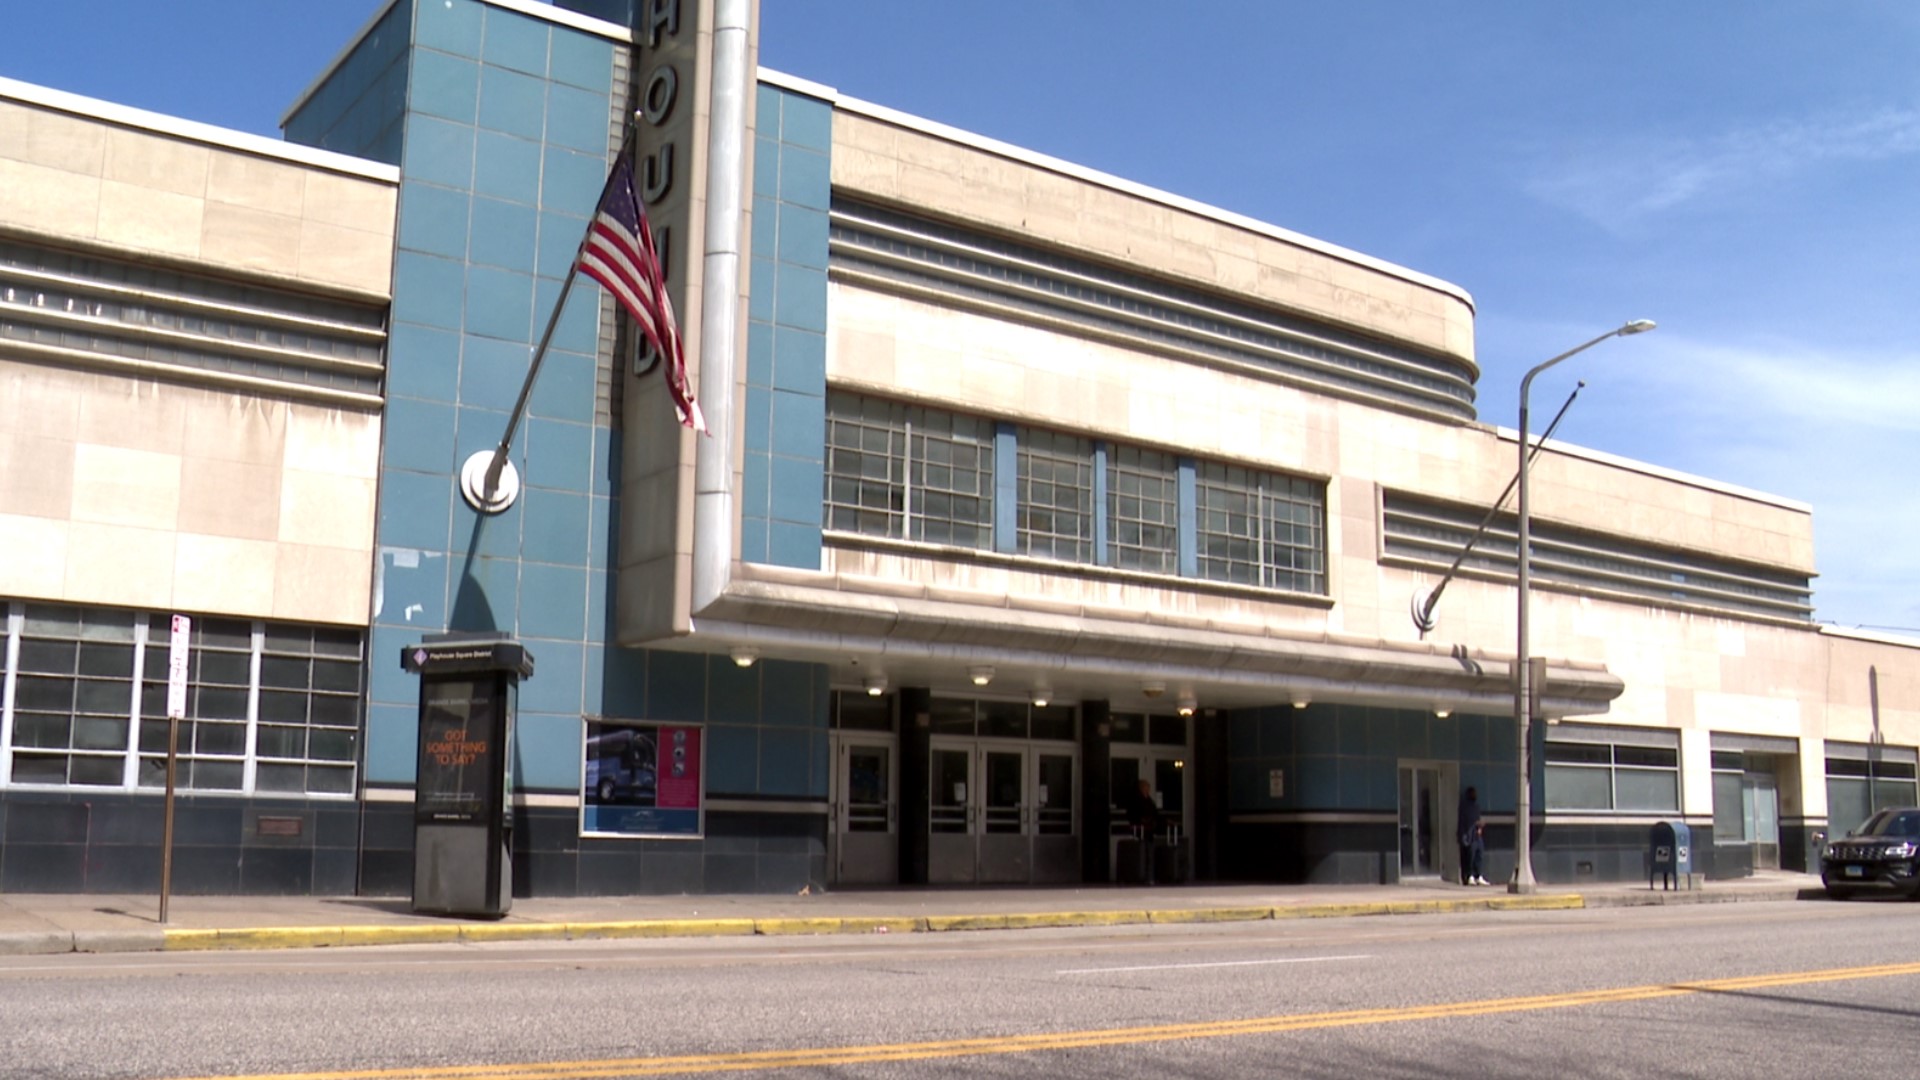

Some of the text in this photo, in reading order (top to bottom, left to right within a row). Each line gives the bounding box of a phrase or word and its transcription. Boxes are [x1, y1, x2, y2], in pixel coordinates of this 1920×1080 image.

[456, 651, 472, 659] Square
[445, 730, 467, 741] GOT
[427, 742, 486, 753] SOMETHING
[436, 754, 475, 765] TO SAY?
